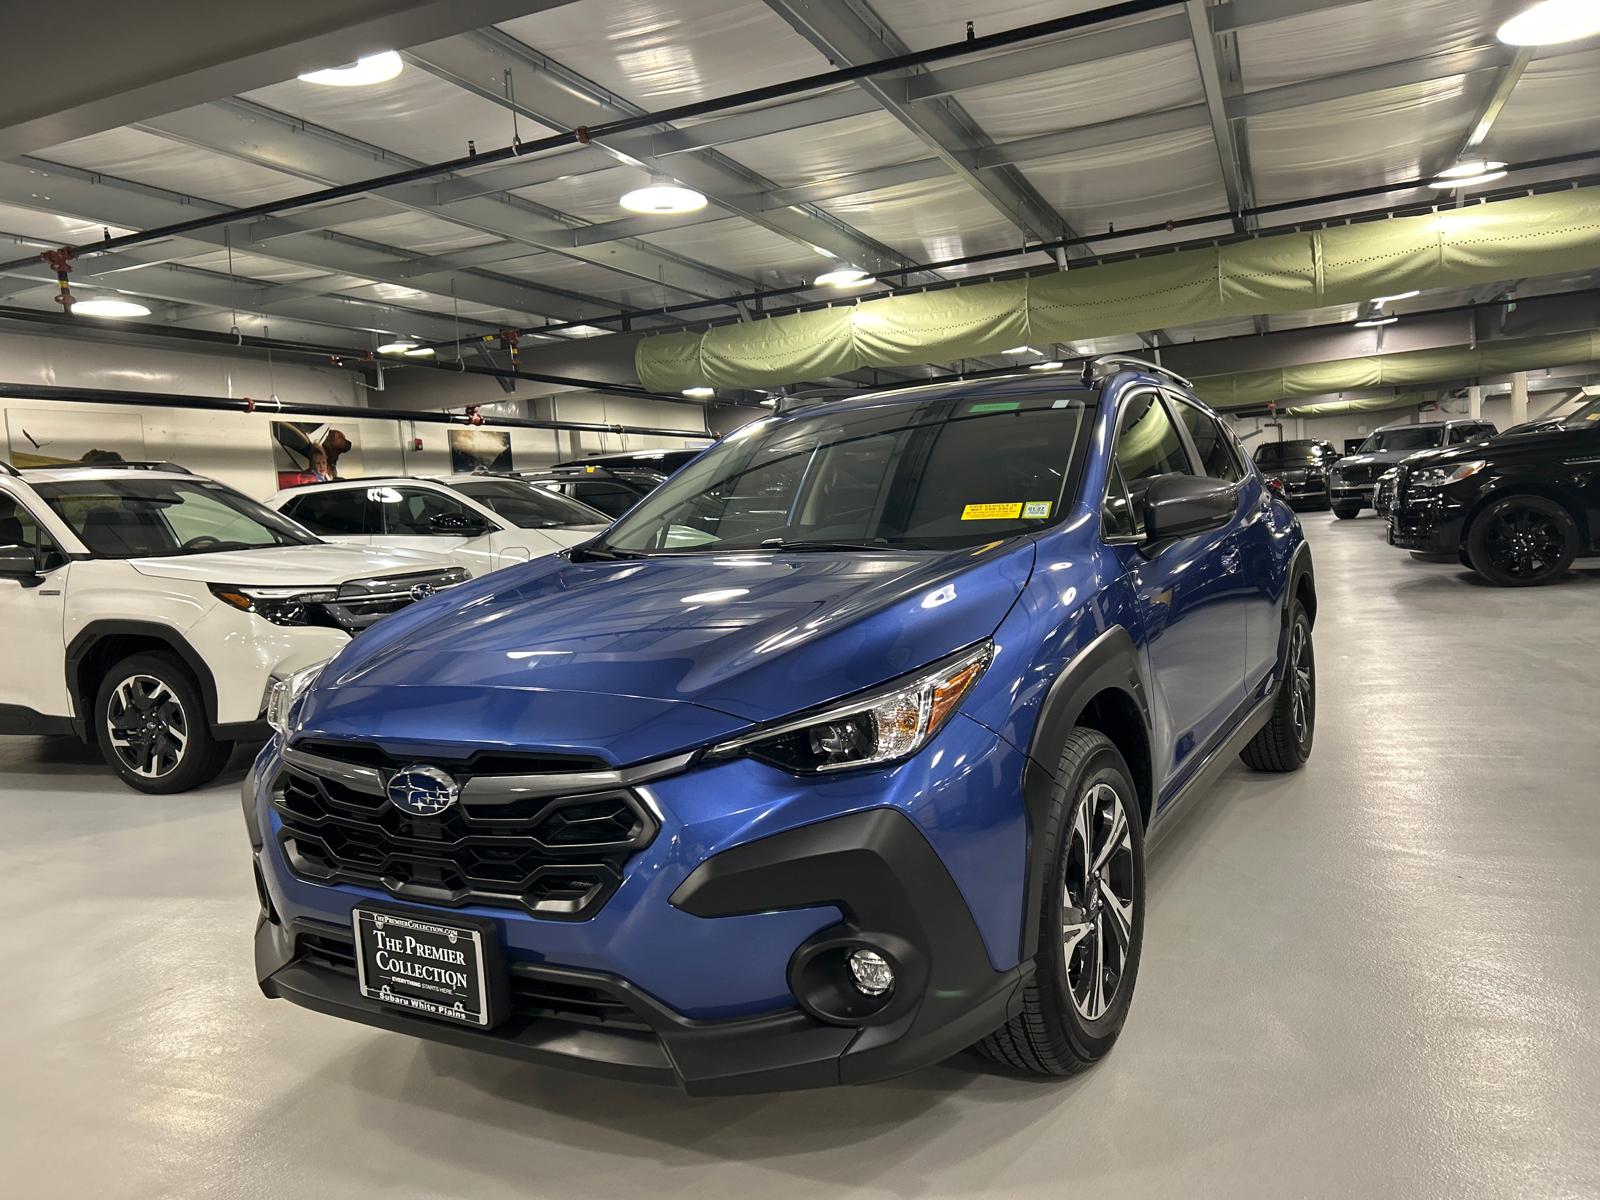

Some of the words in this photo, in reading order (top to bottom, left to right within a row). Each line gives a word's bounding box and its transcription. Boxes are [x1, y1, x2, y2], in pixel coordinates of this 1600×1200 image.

[373, 913, 458, 936] THEPREMIERCOLLECTION.COM
[373, 930, 404, 953] THE
[404, 935, 466, 966] PREMIER
[375, 950, 467, 988] COLLECTION
[391, 976, 421, 988] EVERYTHING
[421, 983, 440, 993] STARTS
[379, 992, 409, 1005] Subaru
[411, 999, 436, 1012] White
[438, 1006, 466, 1020] Plains
